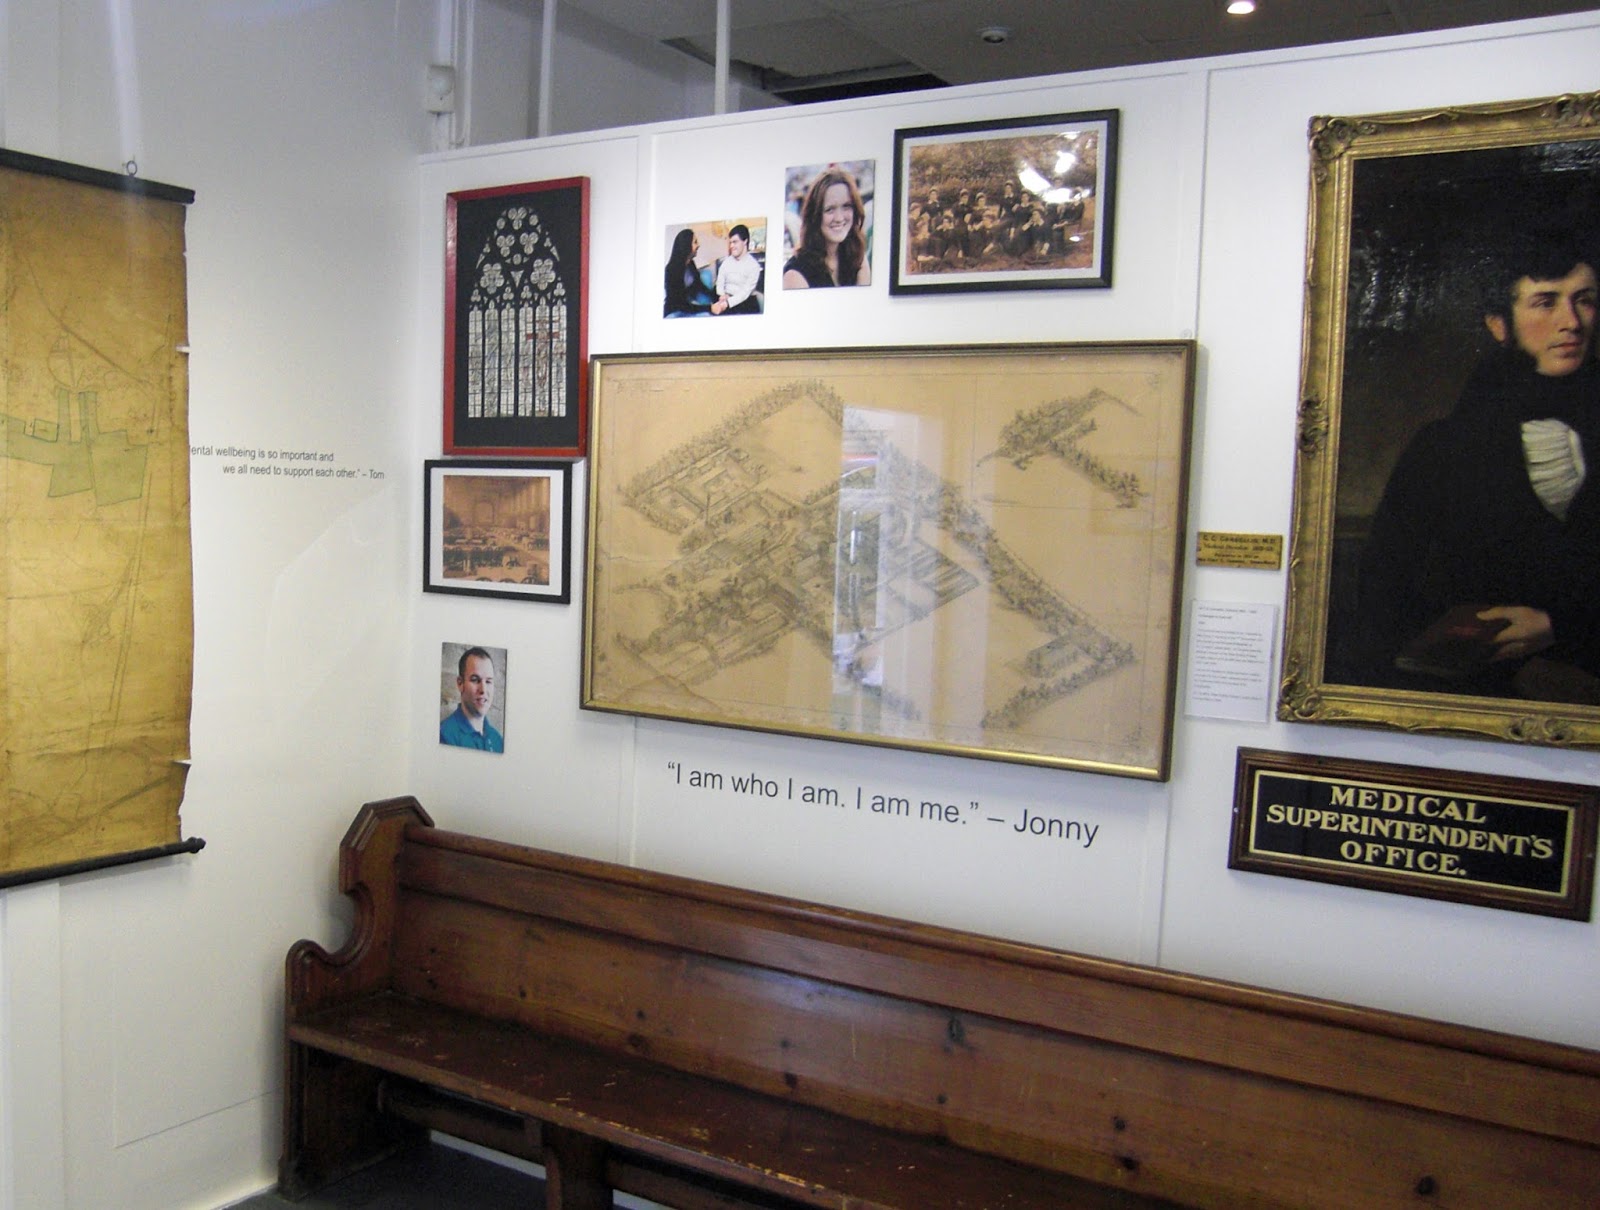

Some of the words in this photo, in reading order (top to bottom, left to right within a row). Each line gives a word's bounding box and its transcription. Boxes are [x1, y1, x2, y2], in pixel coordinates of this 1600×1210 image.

[191, 446, 213, 456] ental
[216, 446, 256, 460] wellbeing
[258, 448, 265, 458] is
[267, 450, 278, 459] so
[279, 449, 317, 462] important
[319, 452, 334, 462] and
[222, 465, 236, 474] we
[237, 464, 248, 474] all
[249, 465, 271, 475] need
[273, 466, 282, 475] to
[283, 467, 313, 478] support
[315, 467, 334, 477] each
[369, 469, 385, 479] Tom
[688, 768, 723, 790] am
[731, 772, 779, 798] who
[787, 778, 793, 800] I
[801, 786, 846, 808] am.
[856, 787, 862, 809] I
[871, 793, 910, 817] am
[919, 801, 979, 825] me.”
[1013, 808, 1100, 848] Jonny
[1329, 785, 1486, 823] MEDICAL
[1266, 804, 1554, 859] SUPERINTENDENT'S
[1339, 840, 1468, 876] OFFICE.
